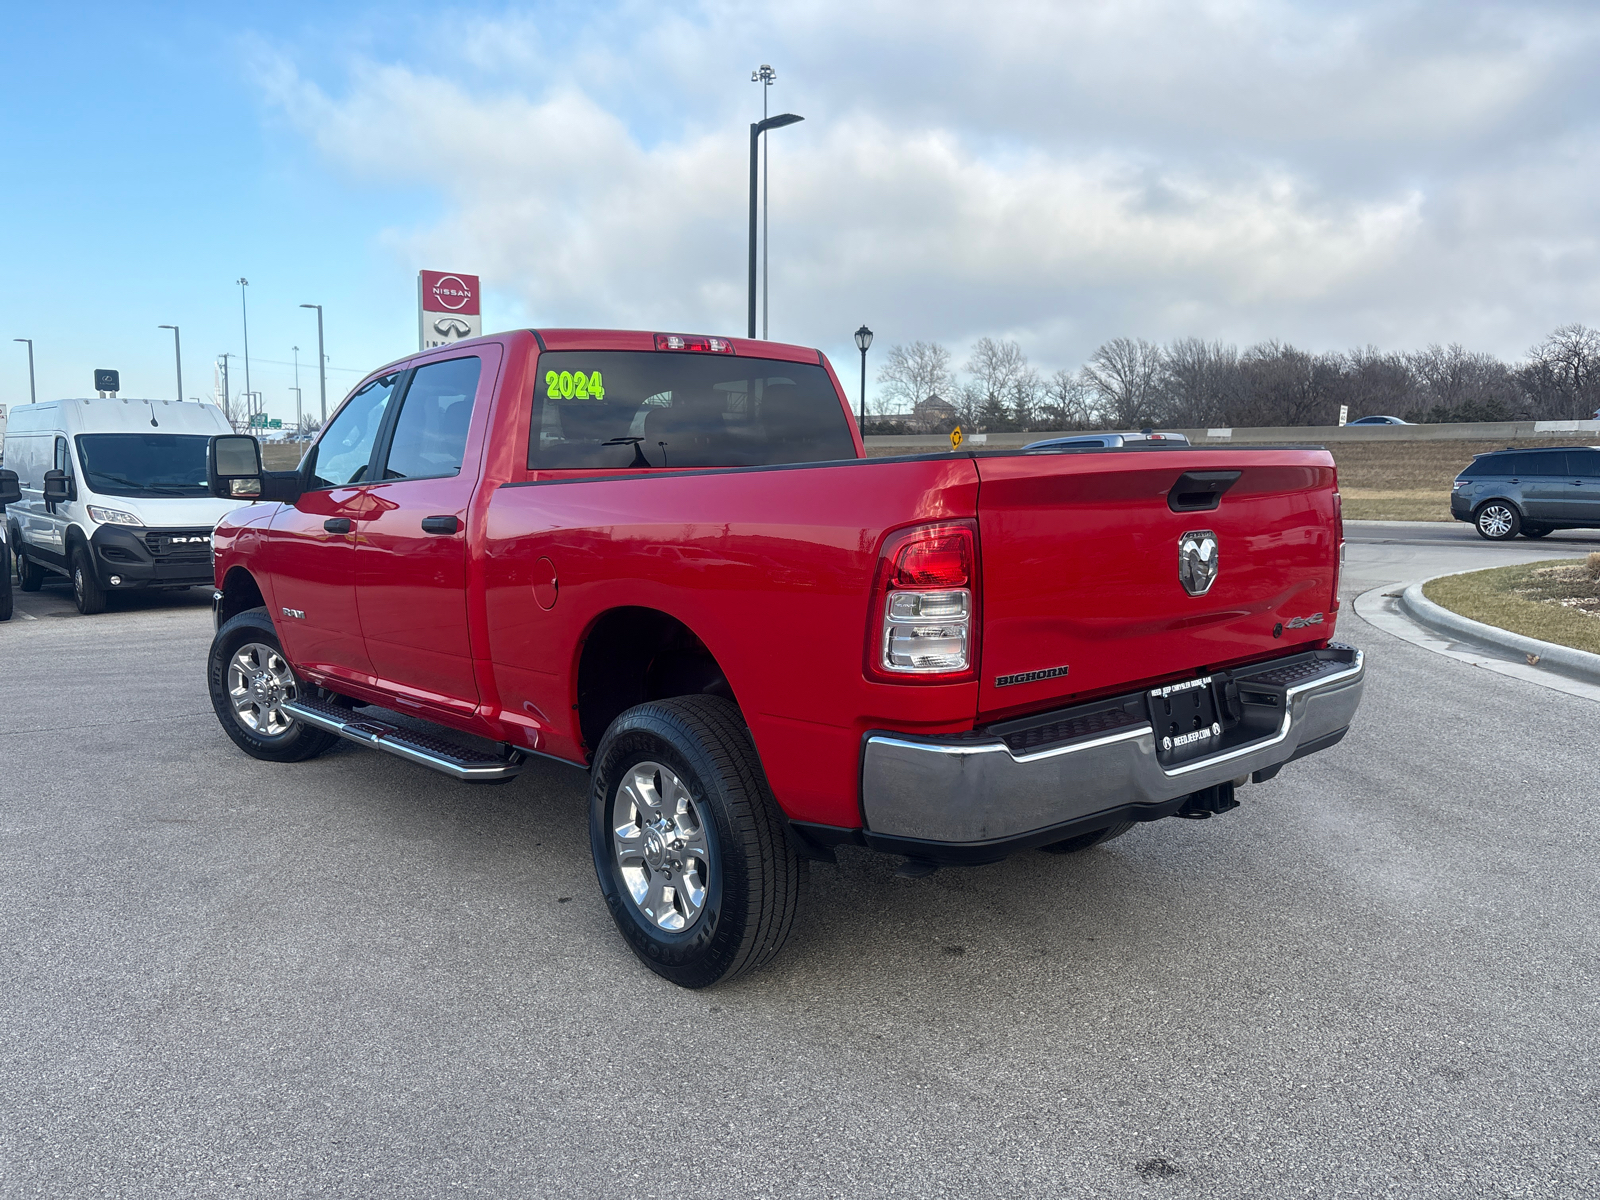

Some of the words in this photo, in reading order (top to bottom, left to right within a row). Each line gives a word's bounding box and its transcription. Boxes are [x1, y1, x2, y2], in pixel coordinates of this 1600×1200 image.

[433, 287, 471, 298] NISSAN
[545, 370, 605, 400] 2024
[282, 607, 306, 619] RAM
[995, 665, 1069, 688] BIGHORN
[1163, 685, 1172, 694] JEEP
[1171, 681, 1190, 692] CHRYSLER
[1190, 679, 1203, 688] DODGE
[1173, 728, 1211, 747] REEDJEEP.COM
